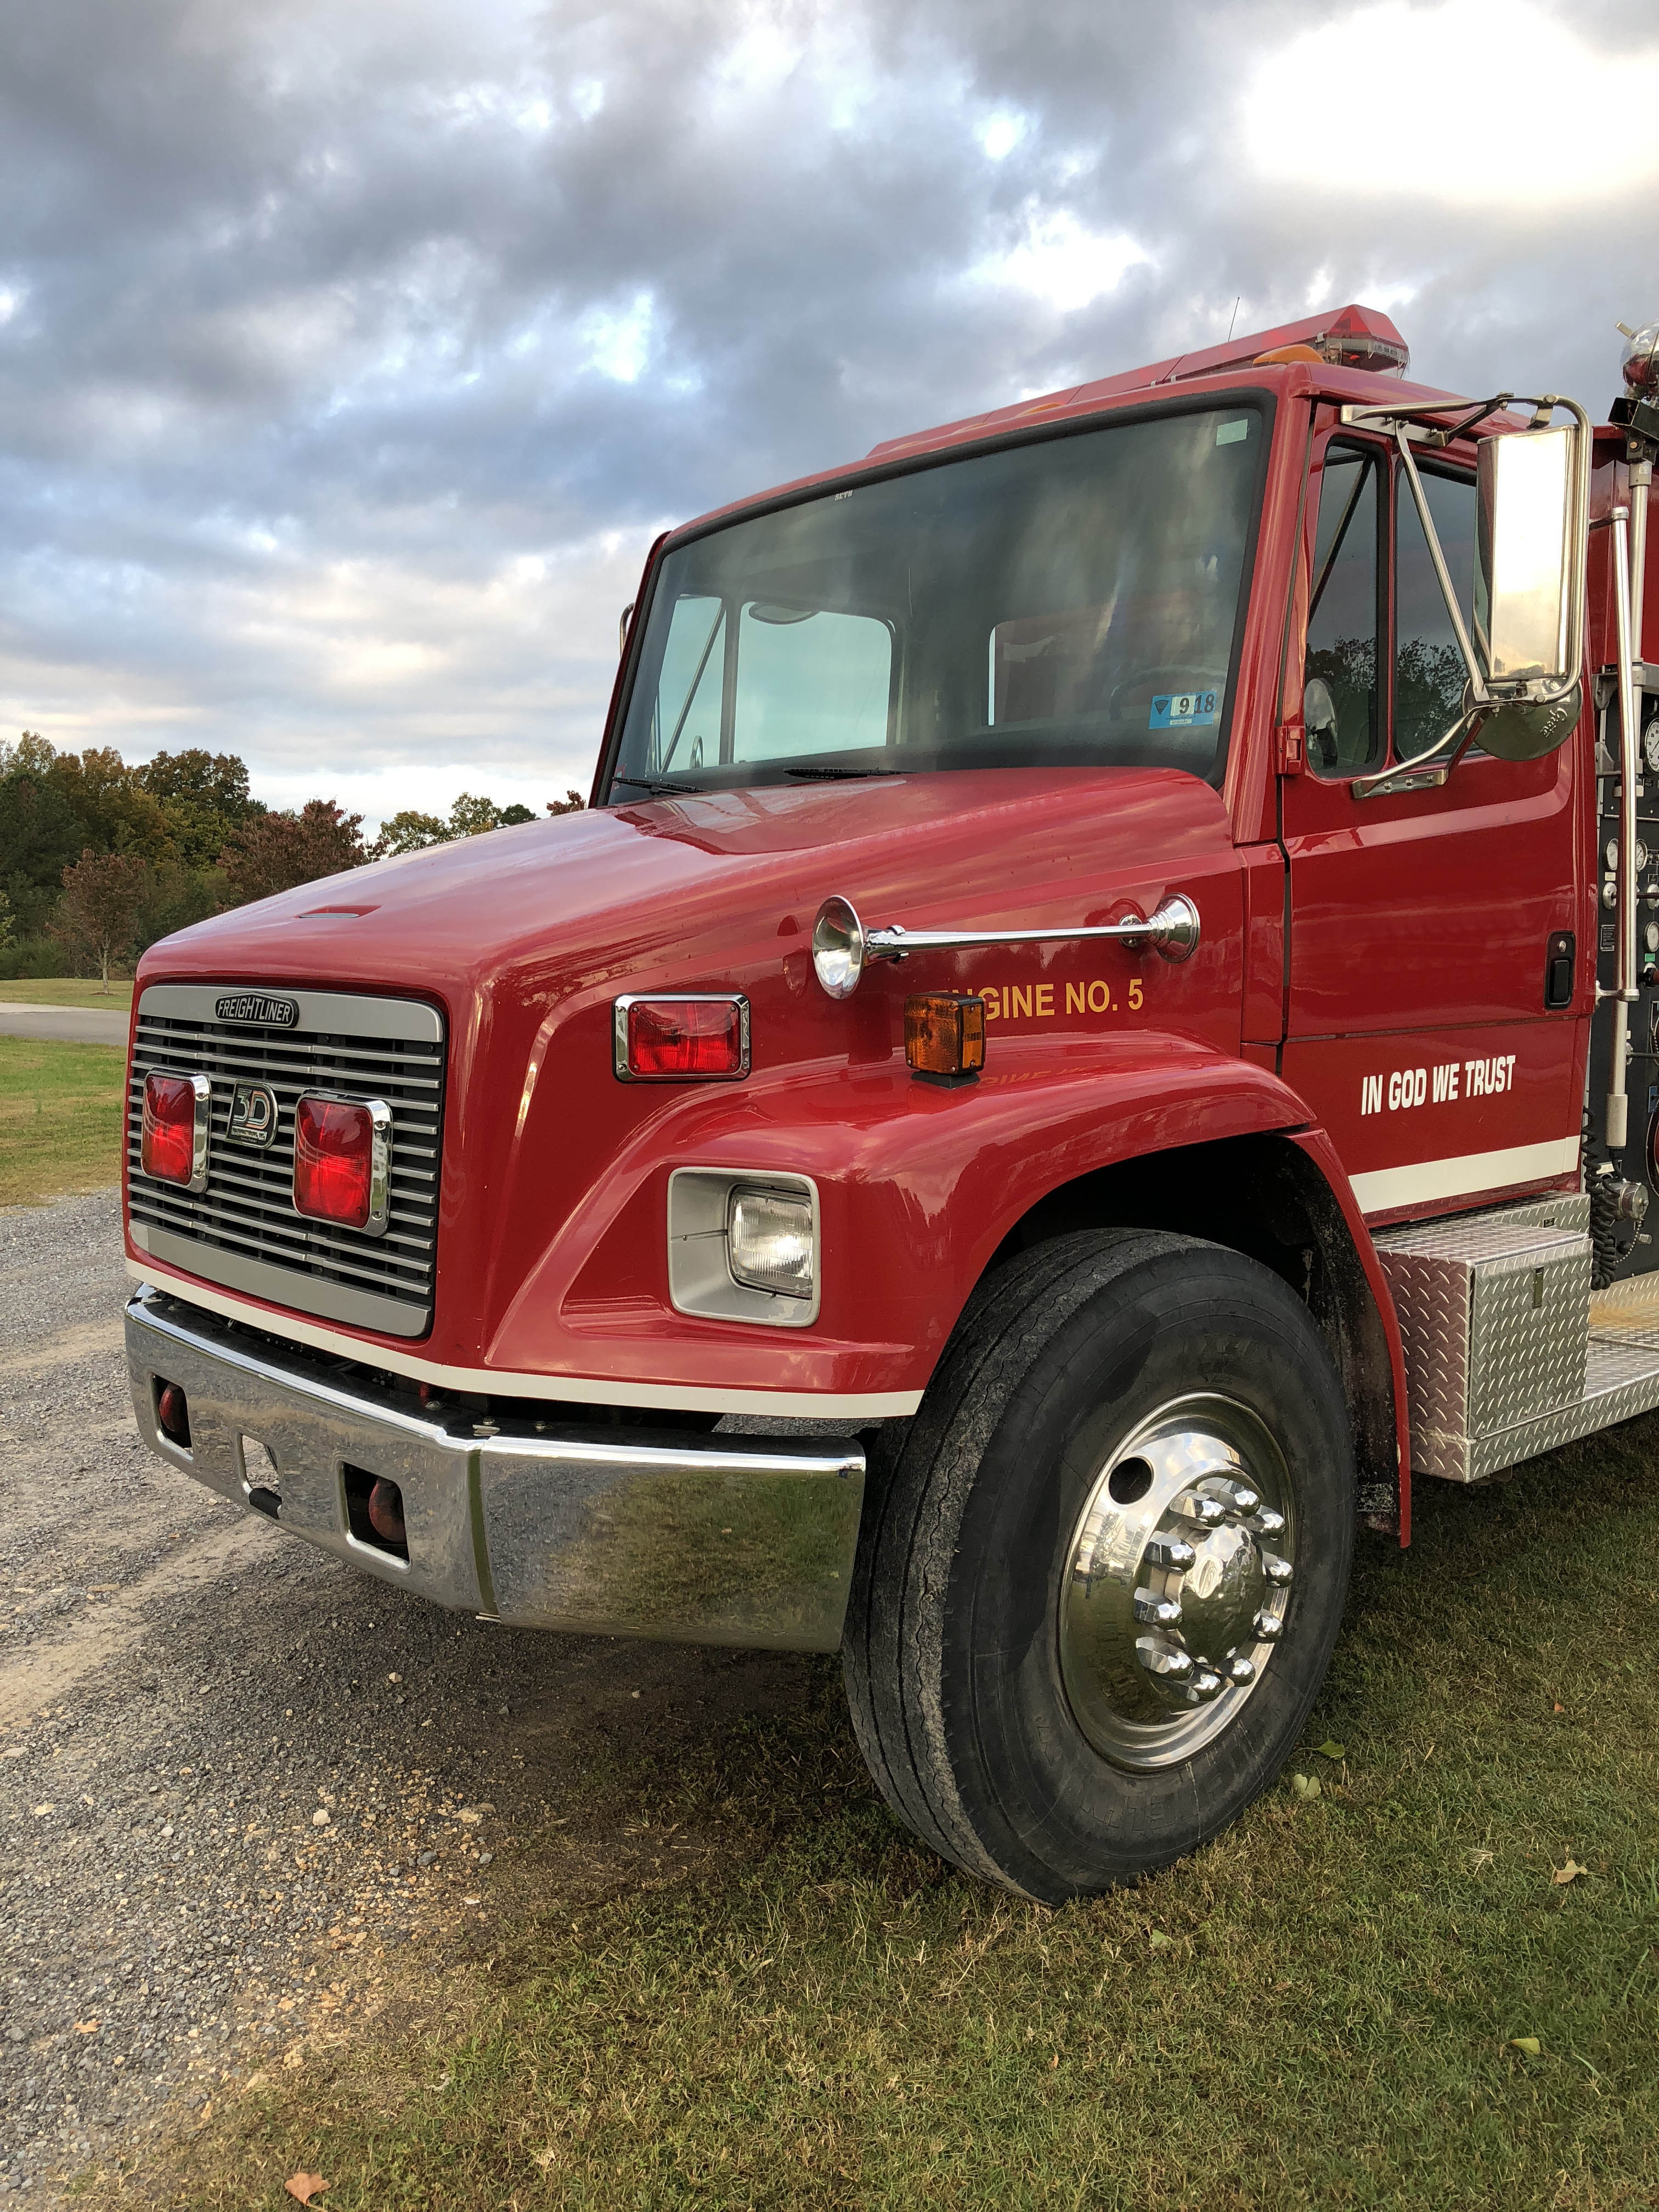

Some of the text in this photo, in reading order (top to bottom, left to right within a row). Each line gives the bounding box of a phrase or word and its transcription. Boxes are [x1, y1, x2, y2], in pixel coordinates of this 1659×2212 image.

[1180, 697, 1190, 714] 9
[1194, 693, 1215, 714] 18
[217, 997, 291, 1022] FREIGHTLINER
[929, 979, 1143, 1020] GINE NO. 5
[1361, 1055, 1516, 1115] IN GOD WE TRUST
[233, 1088, 270, 1130] 3D
